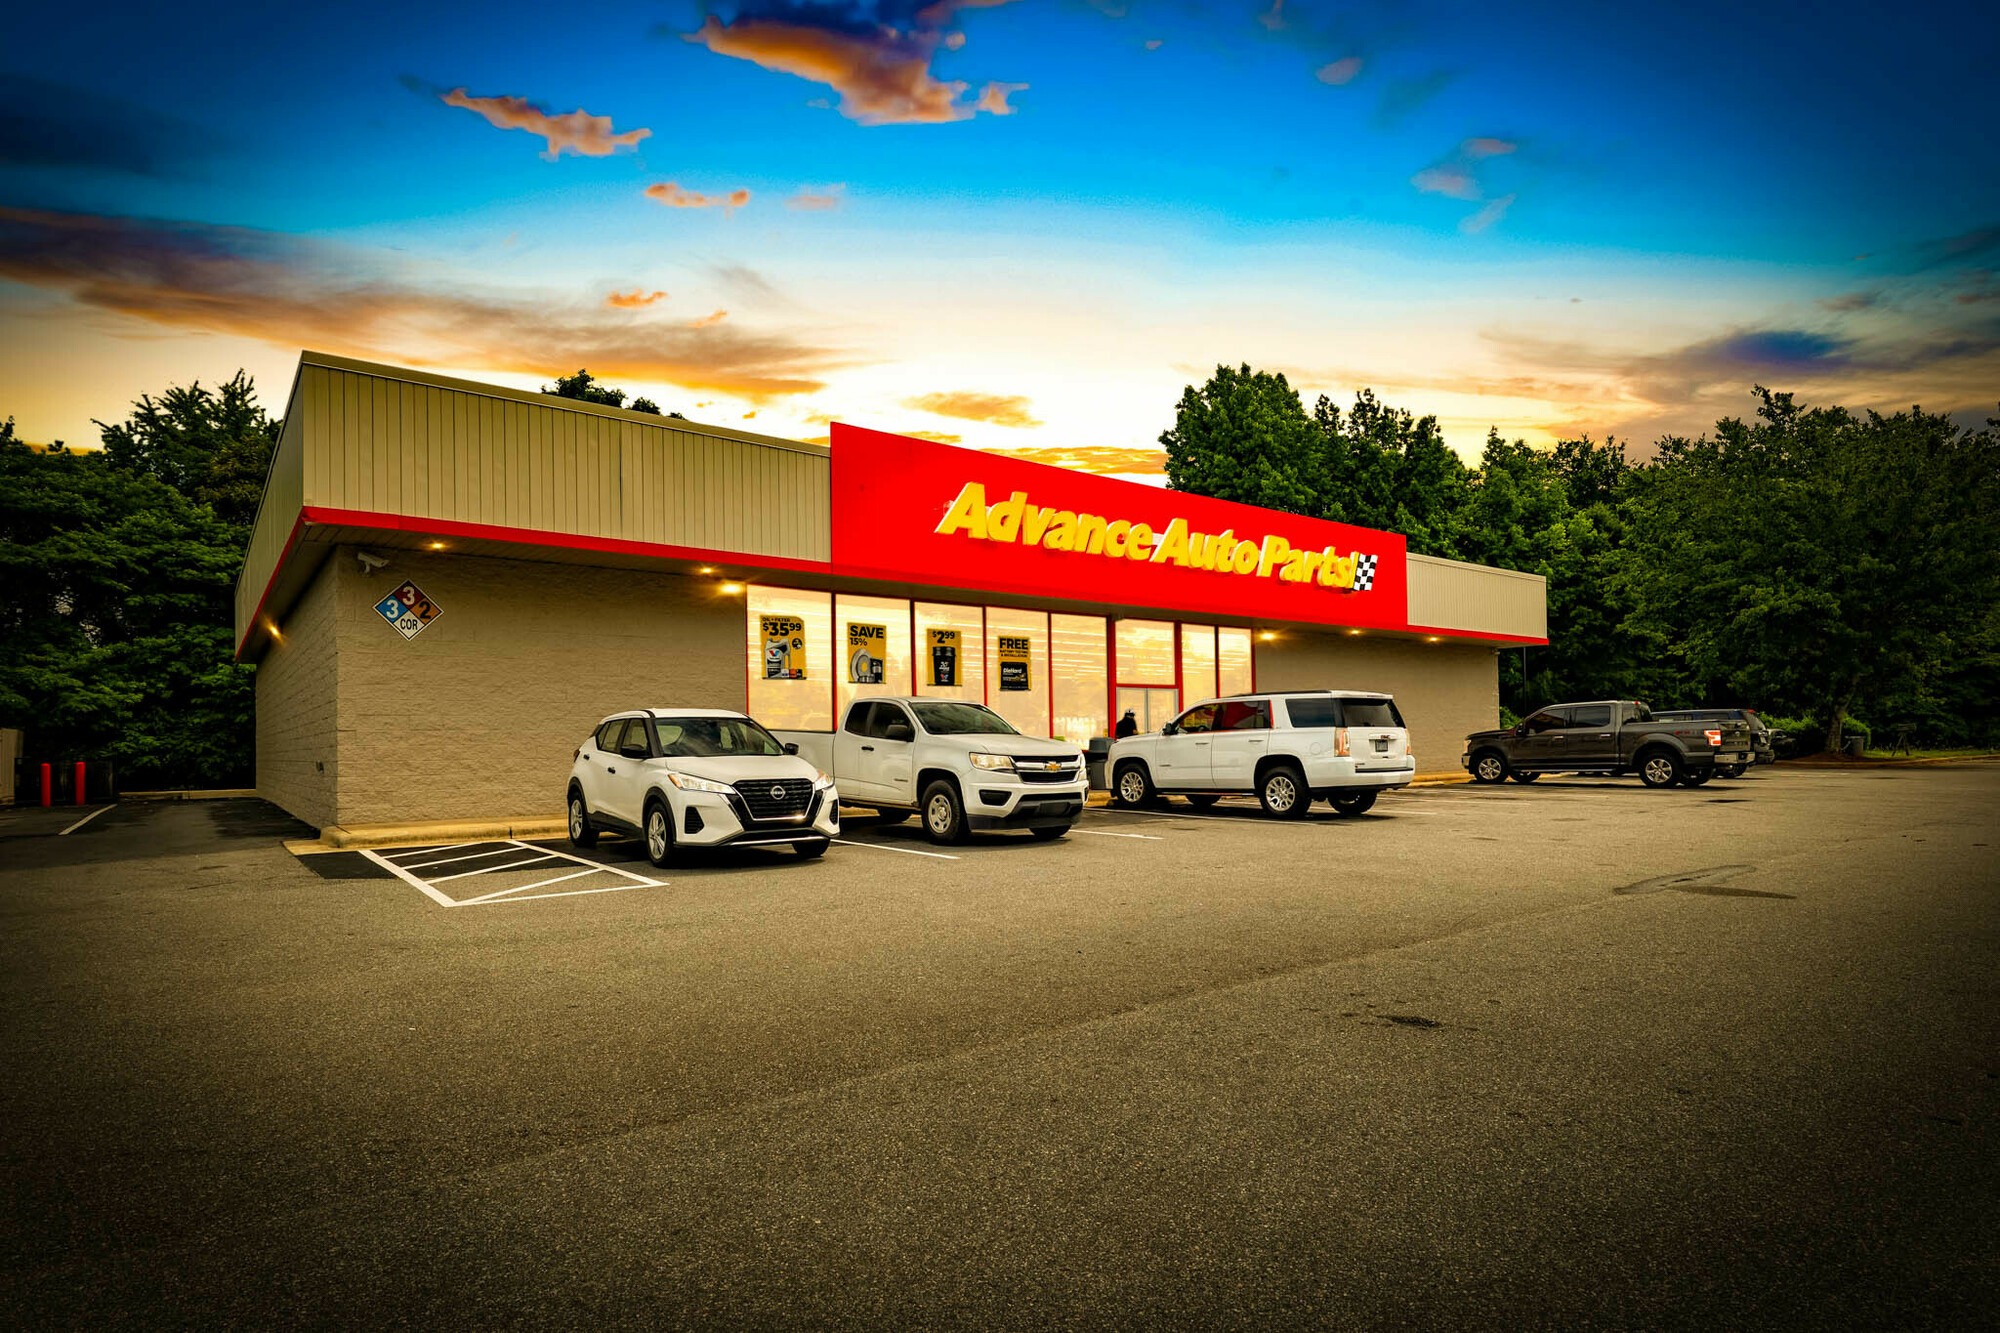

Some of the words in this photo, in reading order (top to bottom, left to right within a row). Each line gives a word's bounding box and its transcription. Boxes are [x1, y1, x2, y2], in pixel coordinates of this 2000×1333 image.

[934, 482, 1153, 560] Advance
[1149, 518, 1259, 575] Auto
[402, 586, 415, 605] 3
[386, 599, 399, 619] 3
[418, 601, 431, 619] 2
[400, 618, 418, 630] COR
[850, 625, 884, 639] SAVE
[850, 637, 868, 646] 15%
[1000, 638, 1028, 650] FREE
